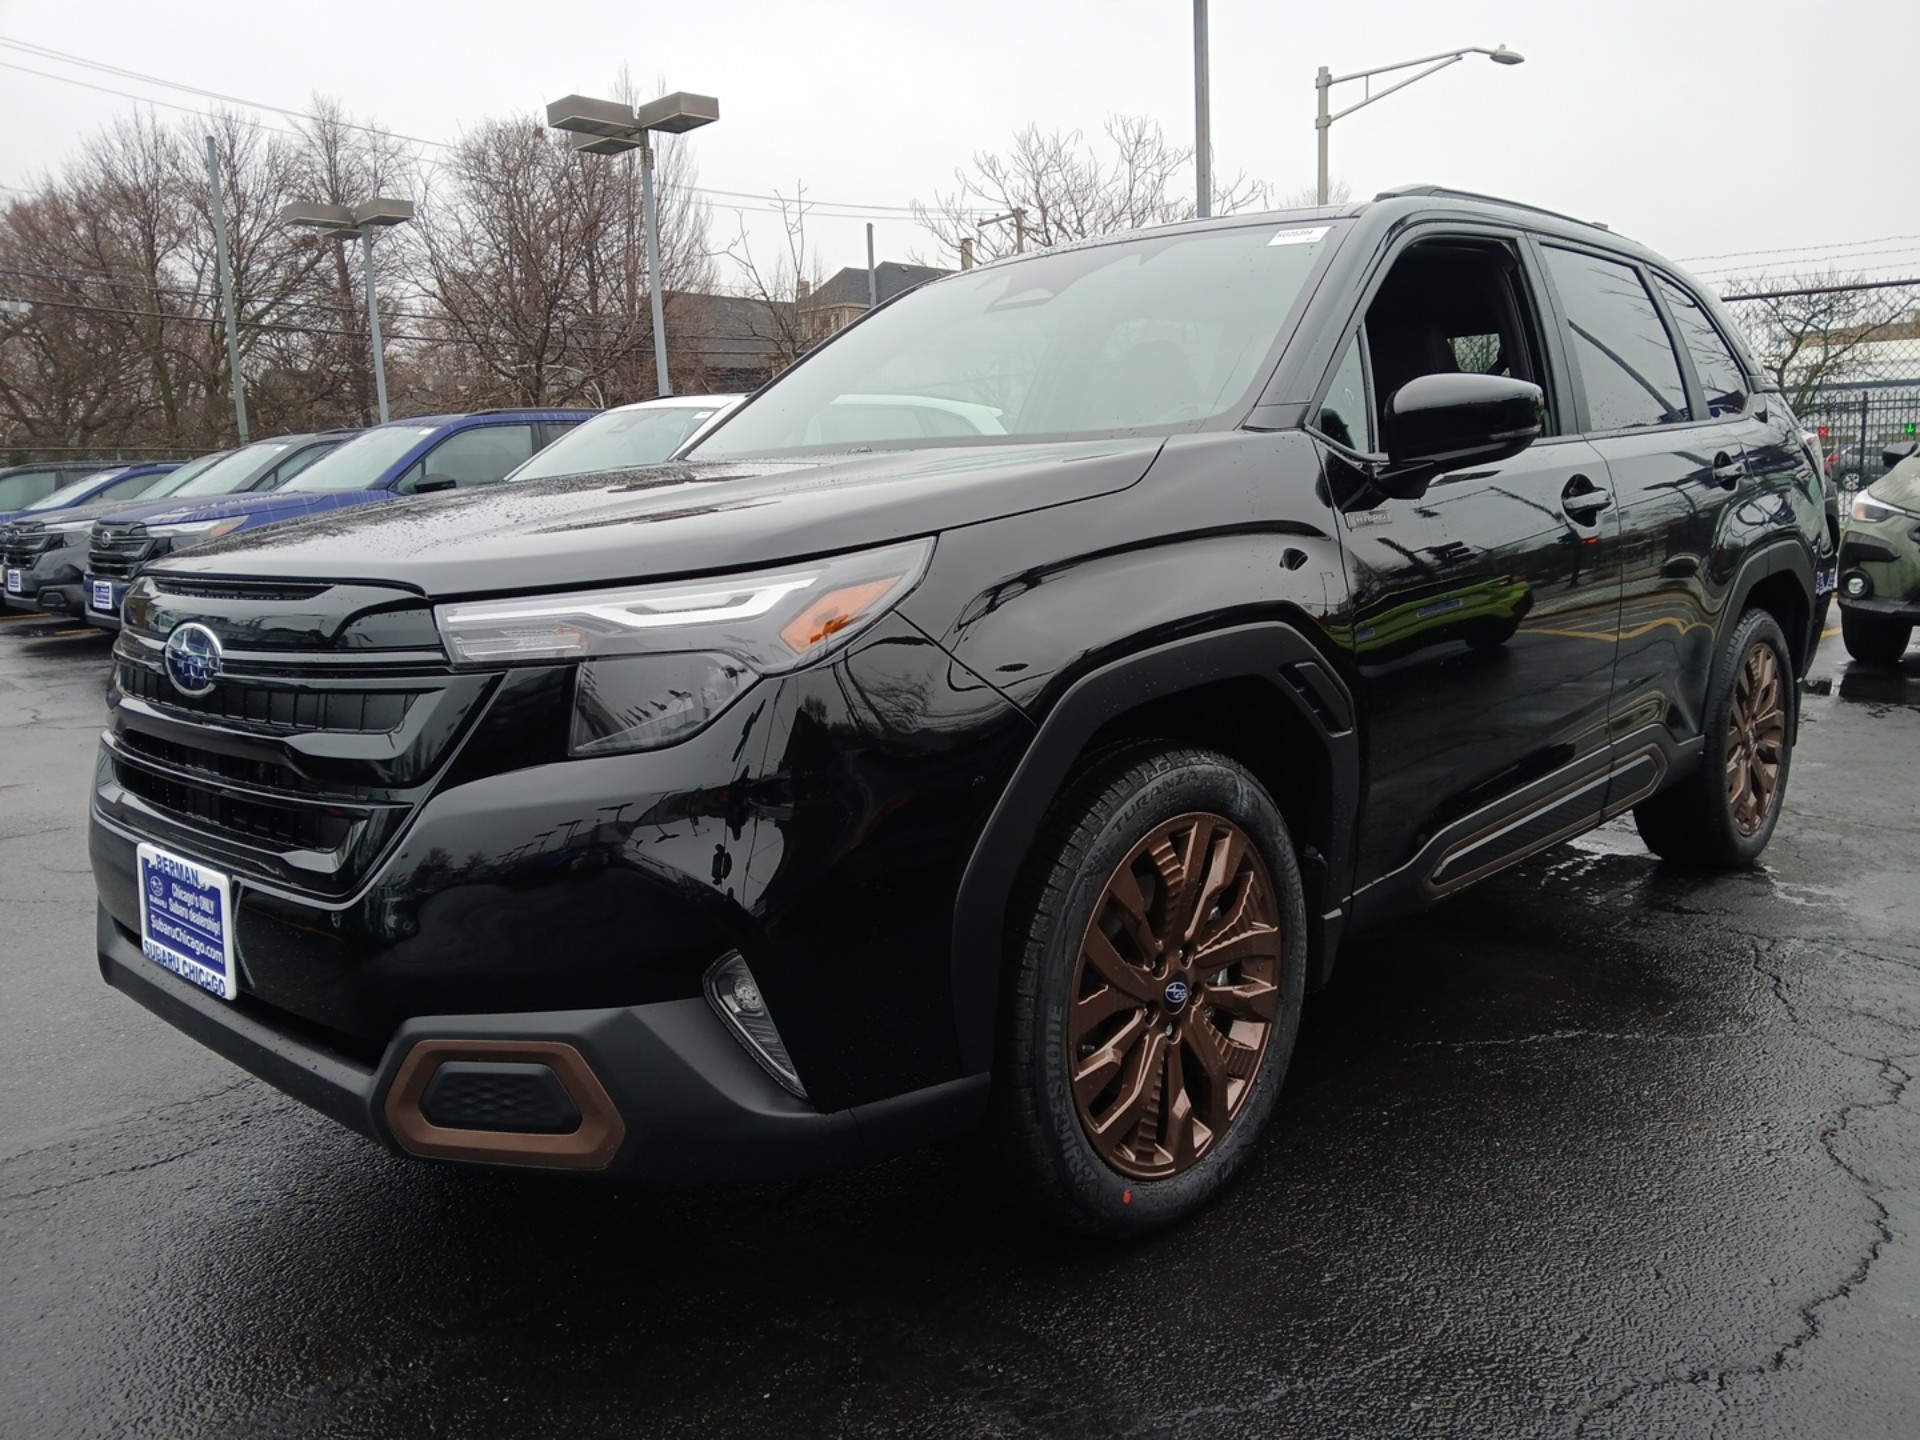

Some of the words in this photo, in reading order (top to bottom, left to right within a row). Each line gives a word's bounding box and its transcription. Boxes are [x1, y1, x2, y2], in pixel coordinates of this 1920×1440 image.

[1111, 771, 1200, 833] TURANZA
[155, 854, 199, 886] BERMAN
[168, 898, 189, 919] Subaru
[199, 894, 214, 914] ONLY
[150, 914, 224, 964] SubaruChicago.com
[144, 940, 180, 975] SUBARU
[182, 960, 226, 997] CHICAGO
